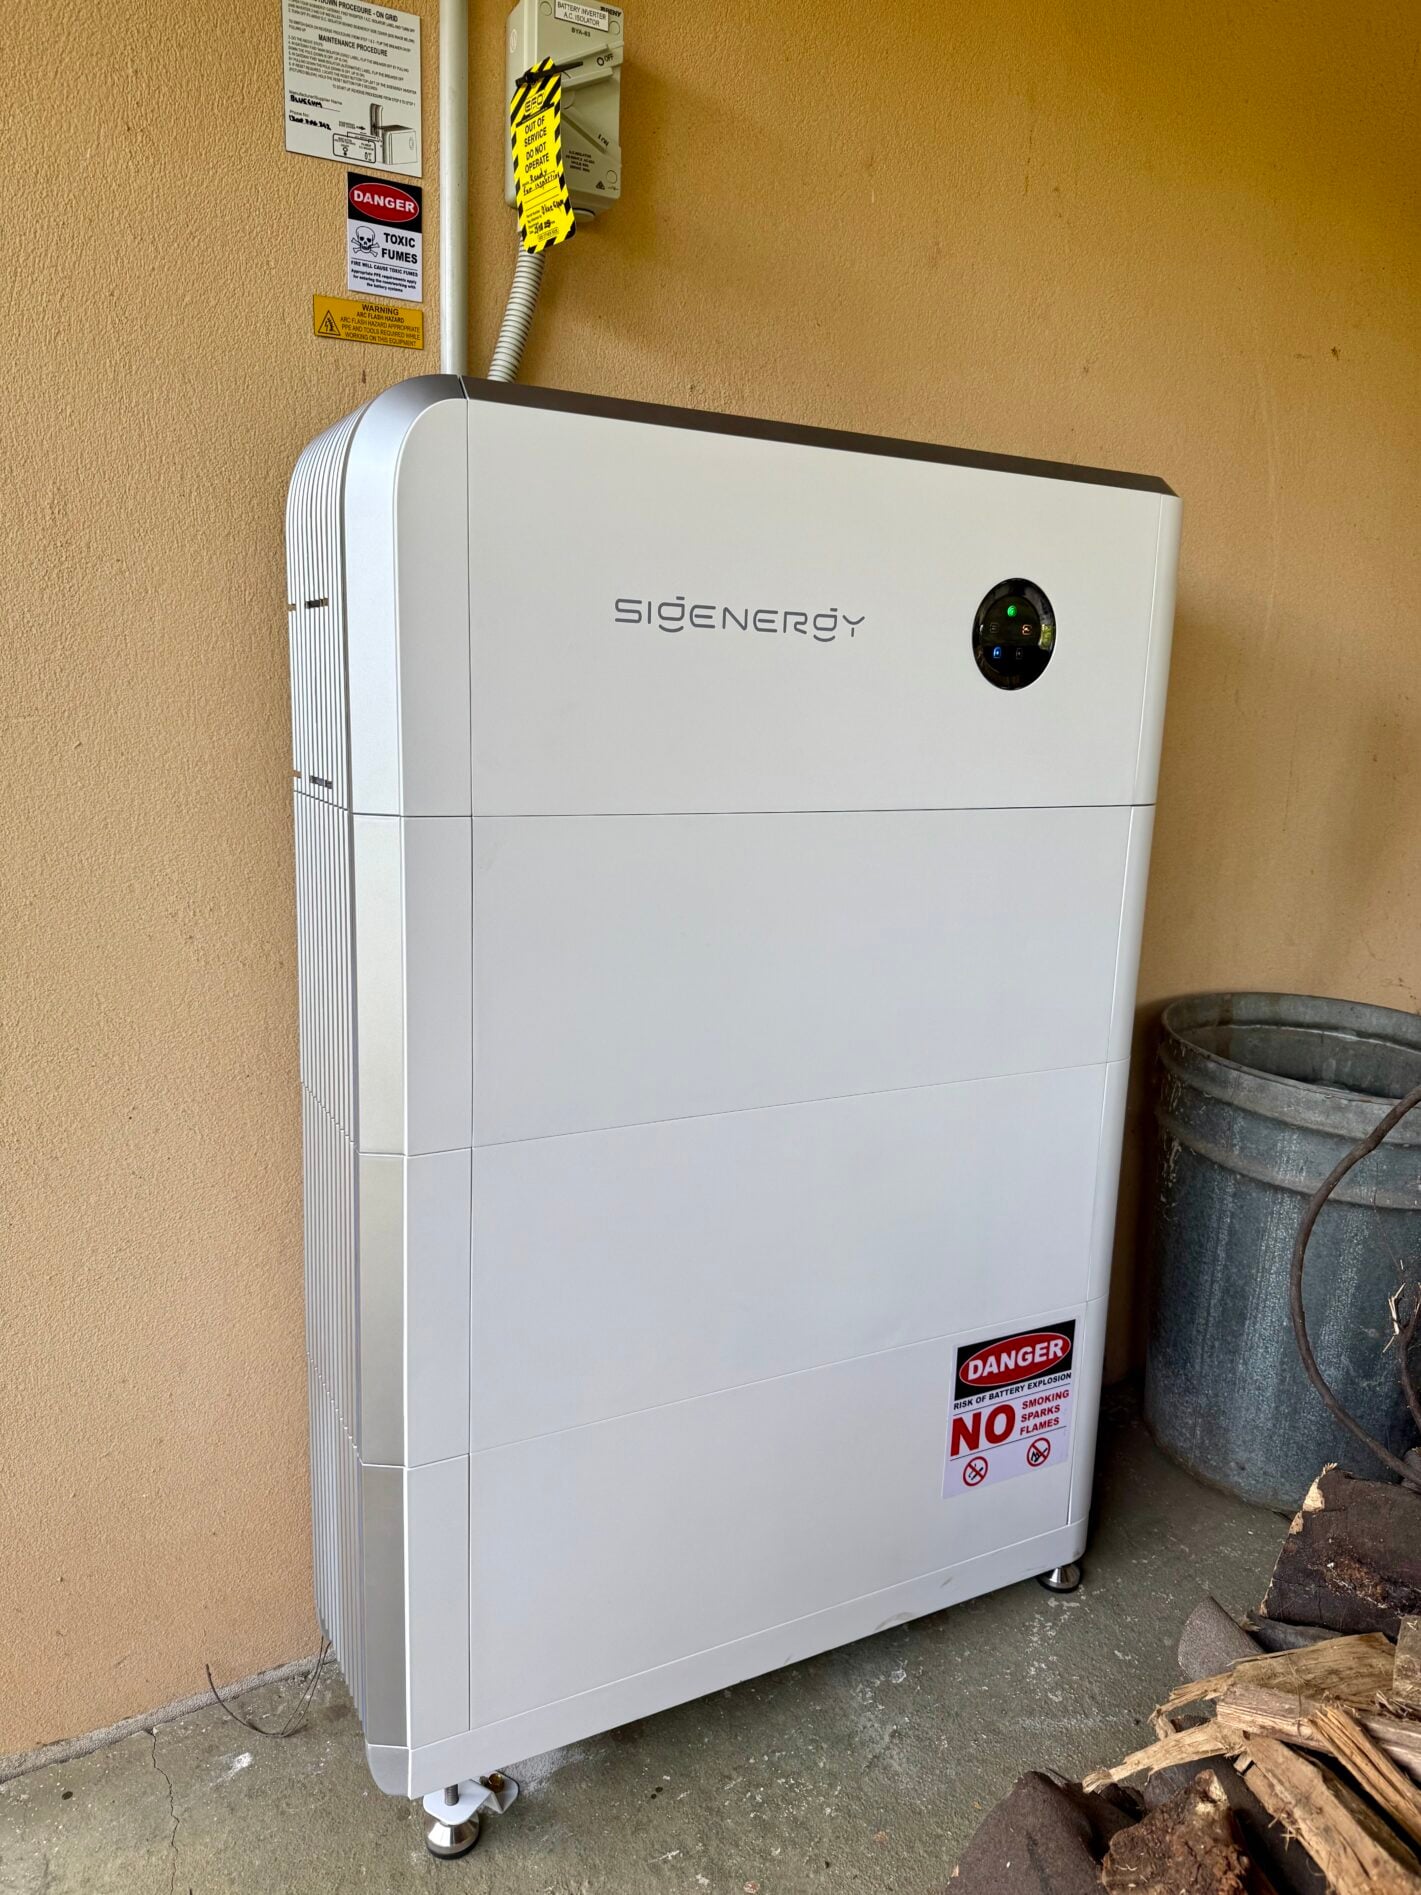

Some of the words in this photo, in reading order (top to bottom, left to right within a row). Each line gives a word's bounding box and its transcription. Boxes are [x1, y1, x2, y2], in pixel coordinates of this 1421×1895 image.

[338, 1, 372, 16] PROCEDURE
[376, 10, 384, 18] ON
[385, 13, 399, 22] GRID
[557, 1, 581, 13] BATTERY
[581, 8, 606, 20] INVERTER
[563, 11, 574, 19] A.C.
[574, 14, 600, 26] ISOLATOR
[318, 34, 355, 50] MAINTENANCE
[356, 43, 388, 57] PROCEDURE
[604, 53, 614, 62] OFF
[525, 120, 536, 134] OUT
[537, 115, 544, 127] OF
[524, 126, 547, 147] SERVICE
[526, 149, 534, 160] DO
[534, 141, 546, 155] NOT
[525, 152, 549, 174] OPERATE
[353, 190, 415, 213] DANGER
[383, 232, 415, 248] TOXIC
[381, 247, 418, 264] FUMES
[361, 304, 399, 315] WARNING
[368, 320, 387, 328] HAZARD
[384, 316, 404, 324] HAZARD
[344, 331, 368, 340] WORKING
[389, 337, 417, 346] EQUIPMENT
[363, 326, 379, 334] TOOLS
[967, 1339, 1064, 1380] DANGER
[953, 1398, 973, 1410] RISK
[975, 1393, 986, 1404] OF
[988, 1384, 1024, 1401] BATTERY
[1027, 1372, 1072, 1391] EXPLOSION
[1022, 1389, 1070, 1410] SMOKING
[1021, 1404, 1060, 1423] SPARKS
[950, 1403, 1016, 1457] NO
[1019, 1417, 1060, 1435] FLAMES
